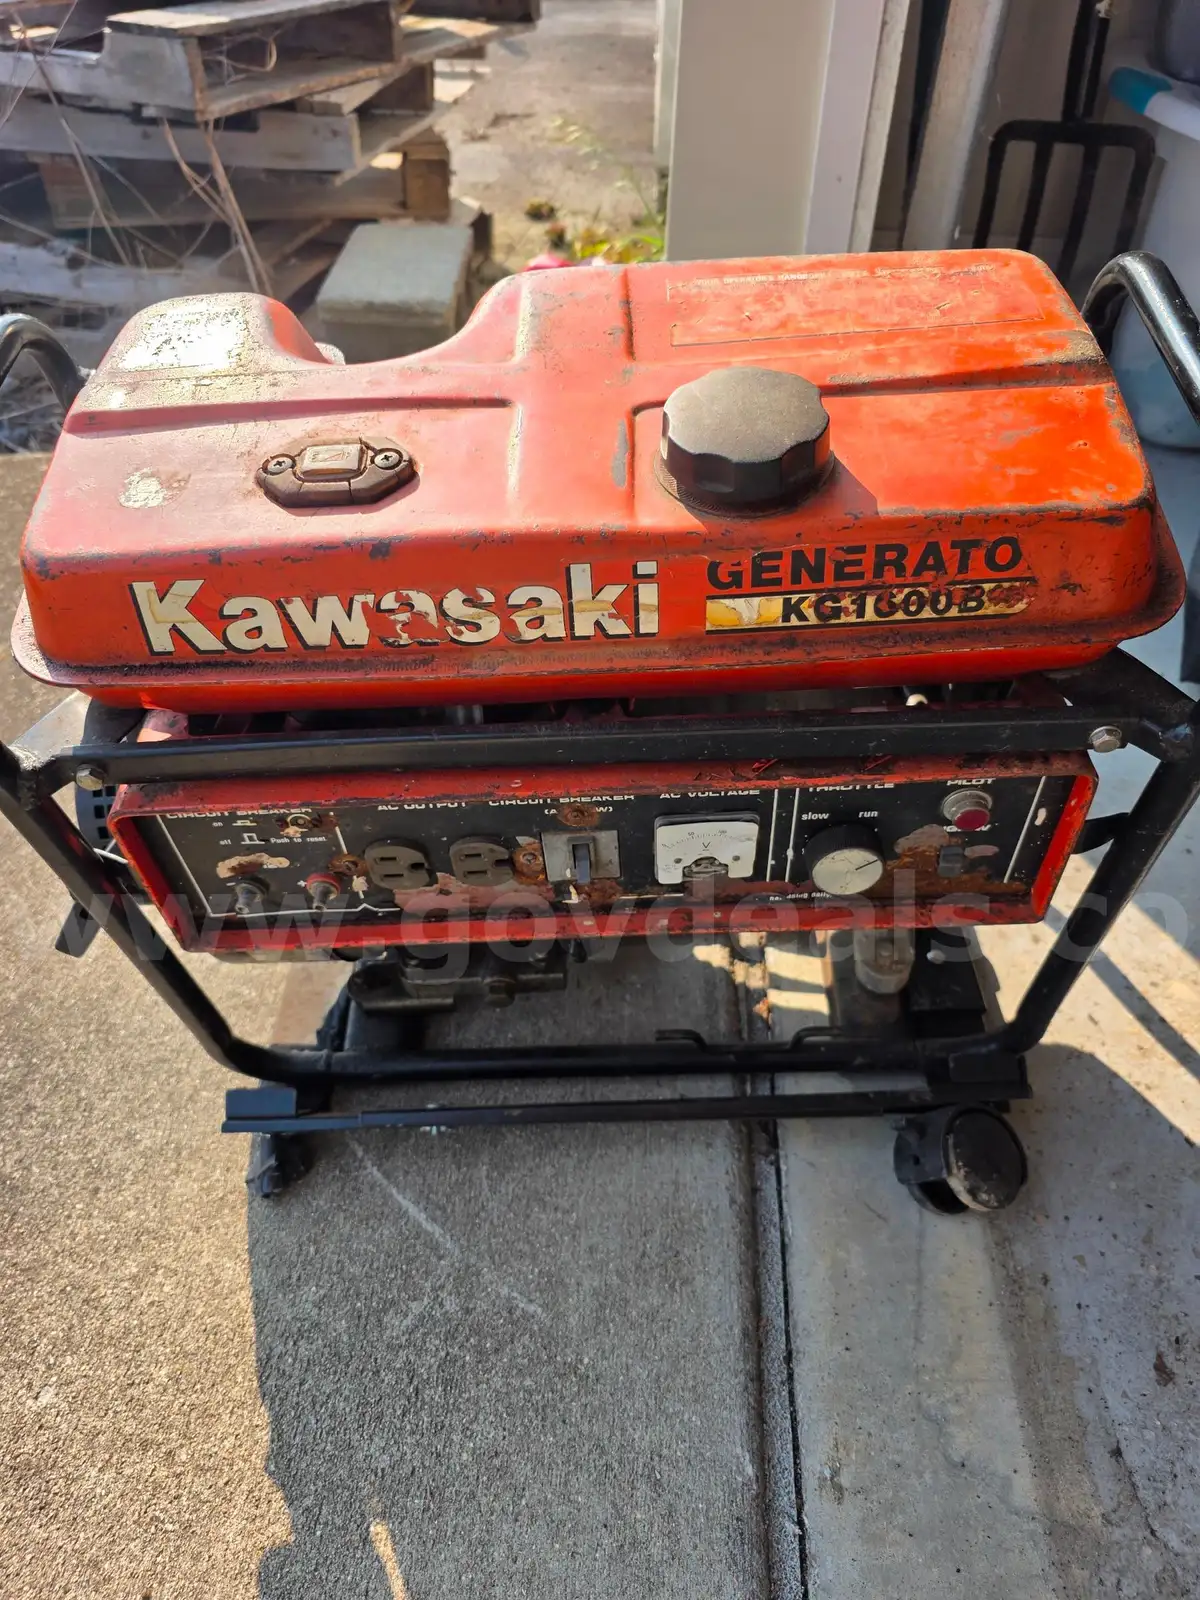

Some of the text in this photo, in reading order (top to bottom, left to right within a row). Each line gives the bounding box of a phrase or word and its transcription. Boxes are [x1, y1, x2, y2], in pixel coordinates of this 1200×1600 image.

[129, 560, 660, 656] Kawasaki
[801, 810, 878, 821] slow run
[270, 837, 290, 845] Push
[702, 841, 711, 849] V
